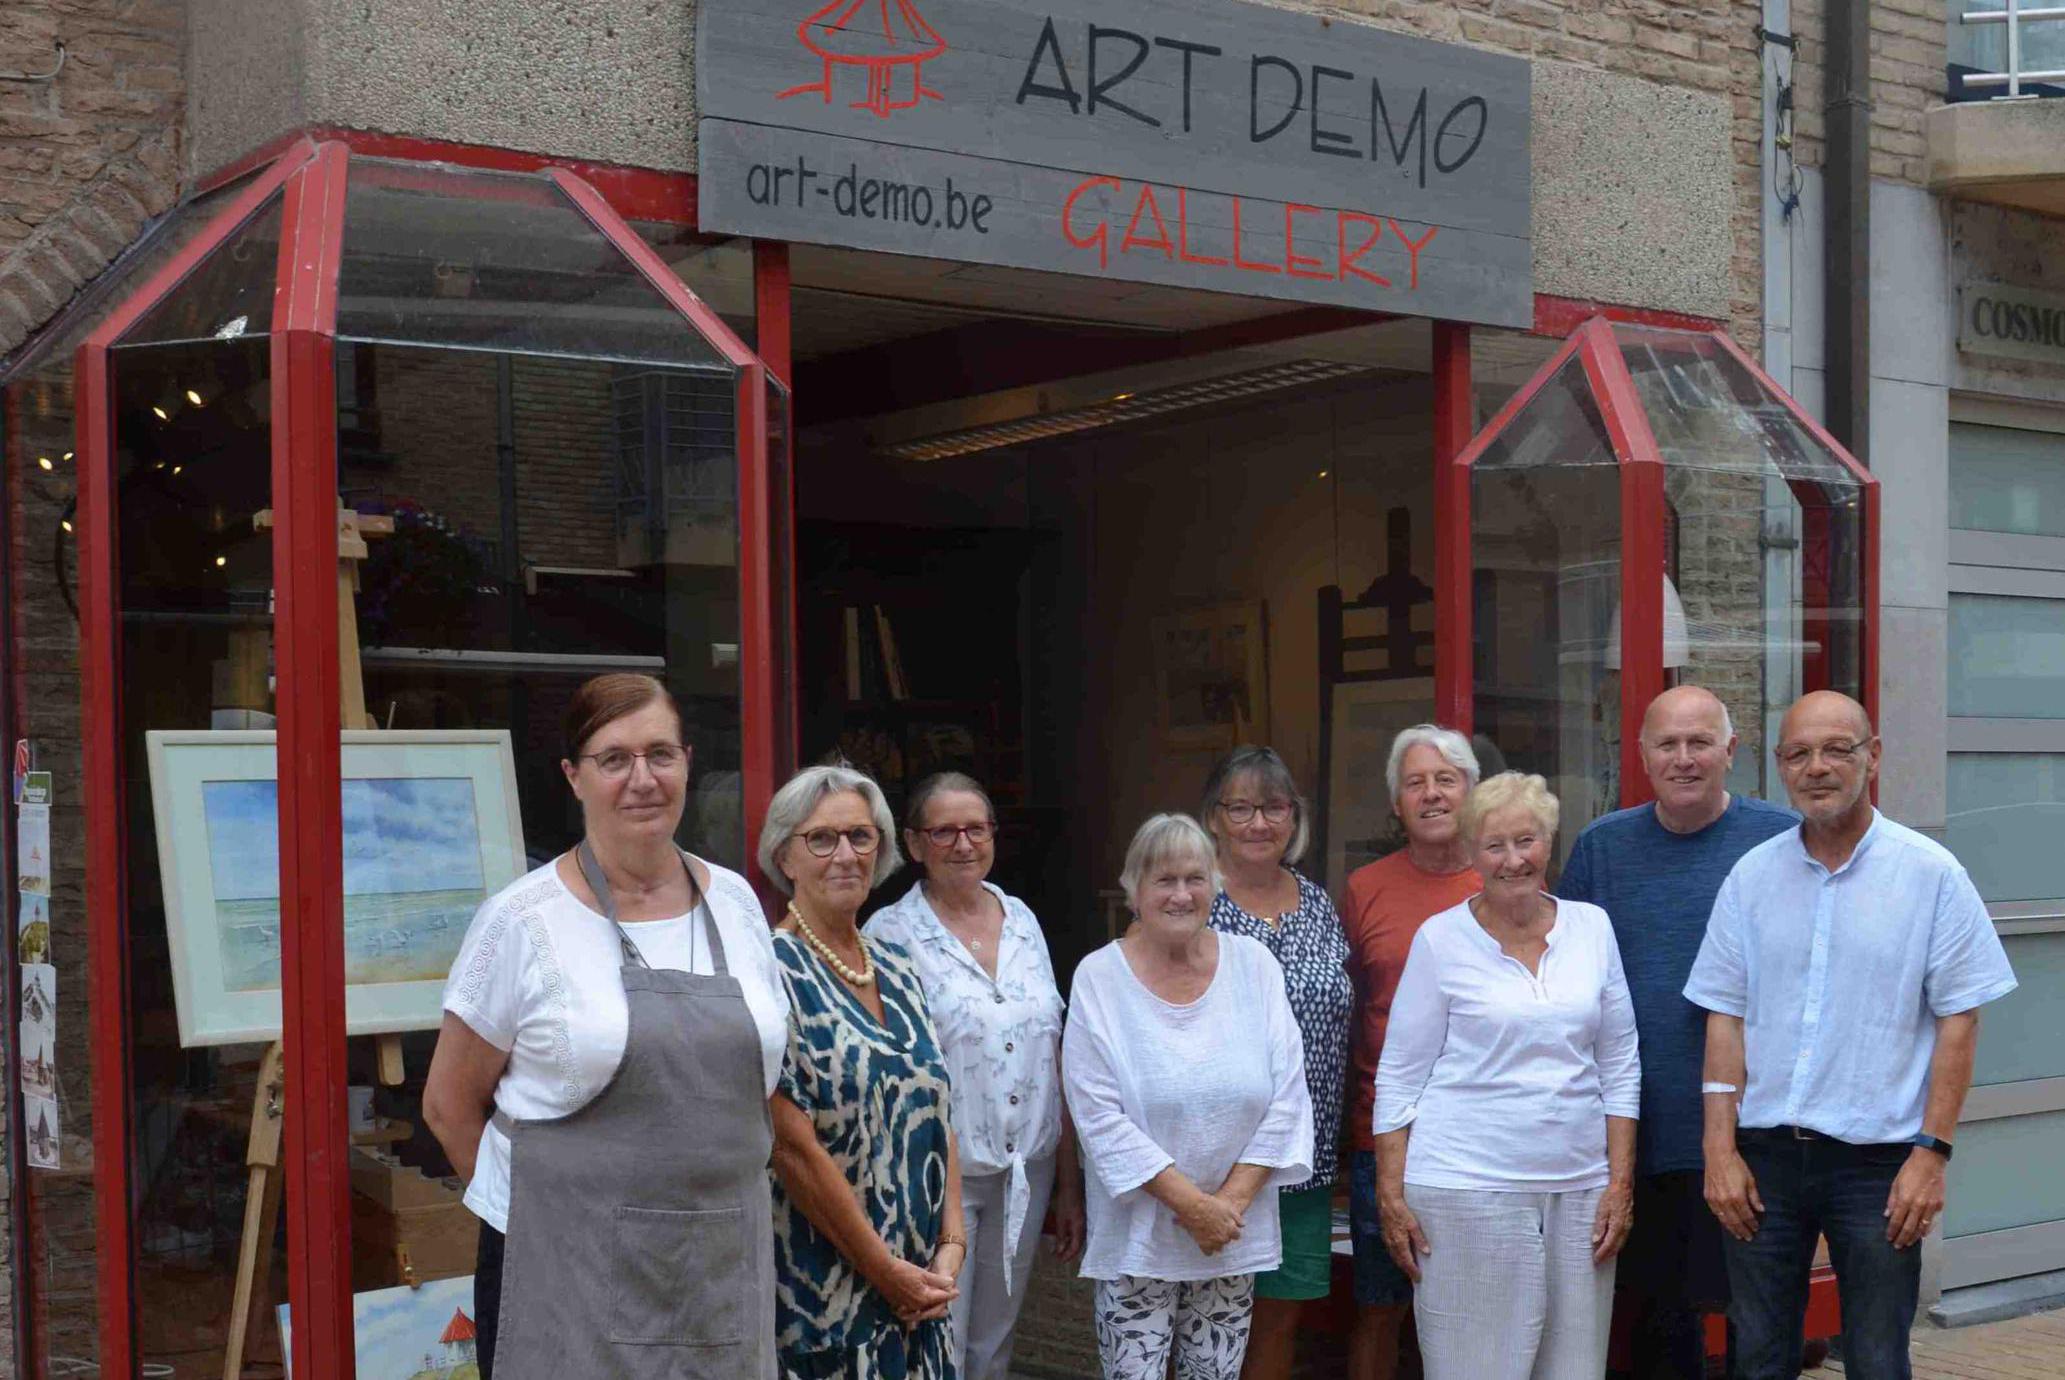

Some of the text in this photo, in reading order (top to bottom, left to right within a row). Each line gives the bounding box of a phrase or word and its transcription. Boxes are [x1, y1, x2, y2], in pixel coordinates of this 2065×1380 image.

[1015, 16, 1488, 189] ART DEMO
[746, 156, 993, 234] art-demo.be
[1062, 175, 1438, 290] GALLERY
